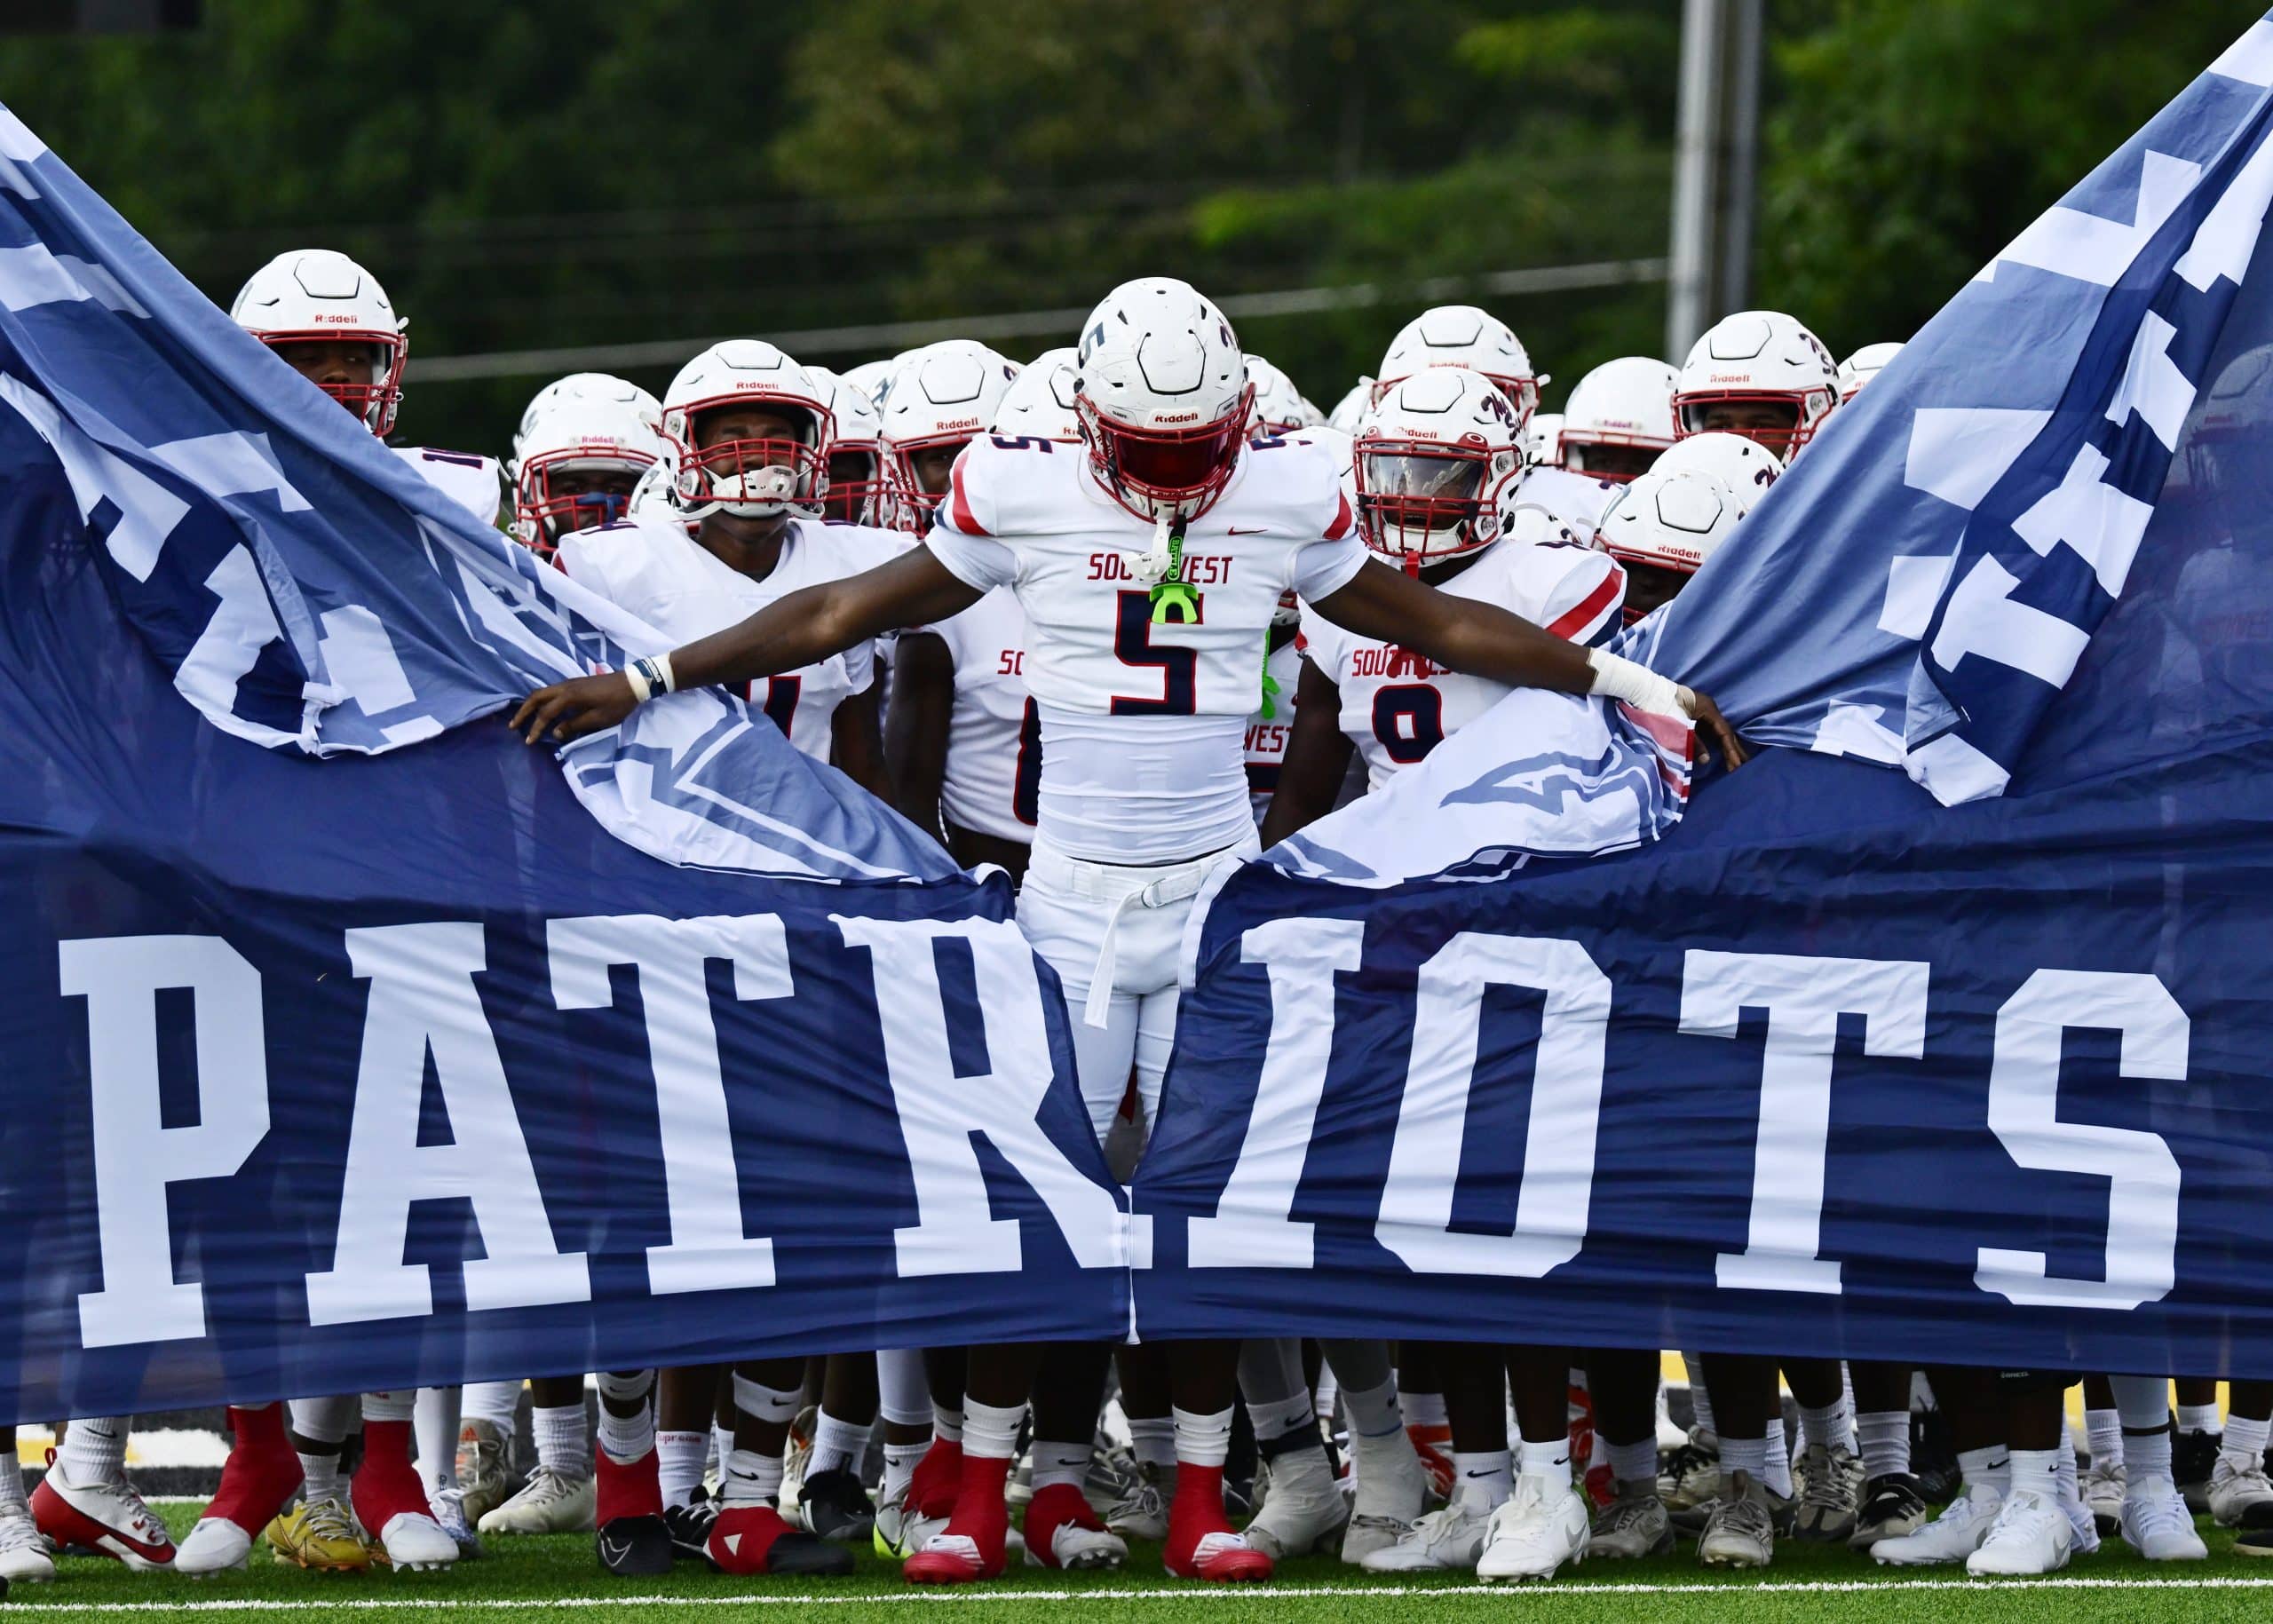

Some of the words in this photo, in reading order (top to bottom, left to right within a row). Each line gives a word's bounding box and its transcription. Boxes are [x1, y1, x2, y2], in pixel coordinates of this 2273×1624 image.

[936, 416, 979, 431] Riddell
[1154, 412, 1199, 424] Riddell
[1111, 588, 1205, 716] 5
[59, 912, 2190, 1349] PATRIOTS
